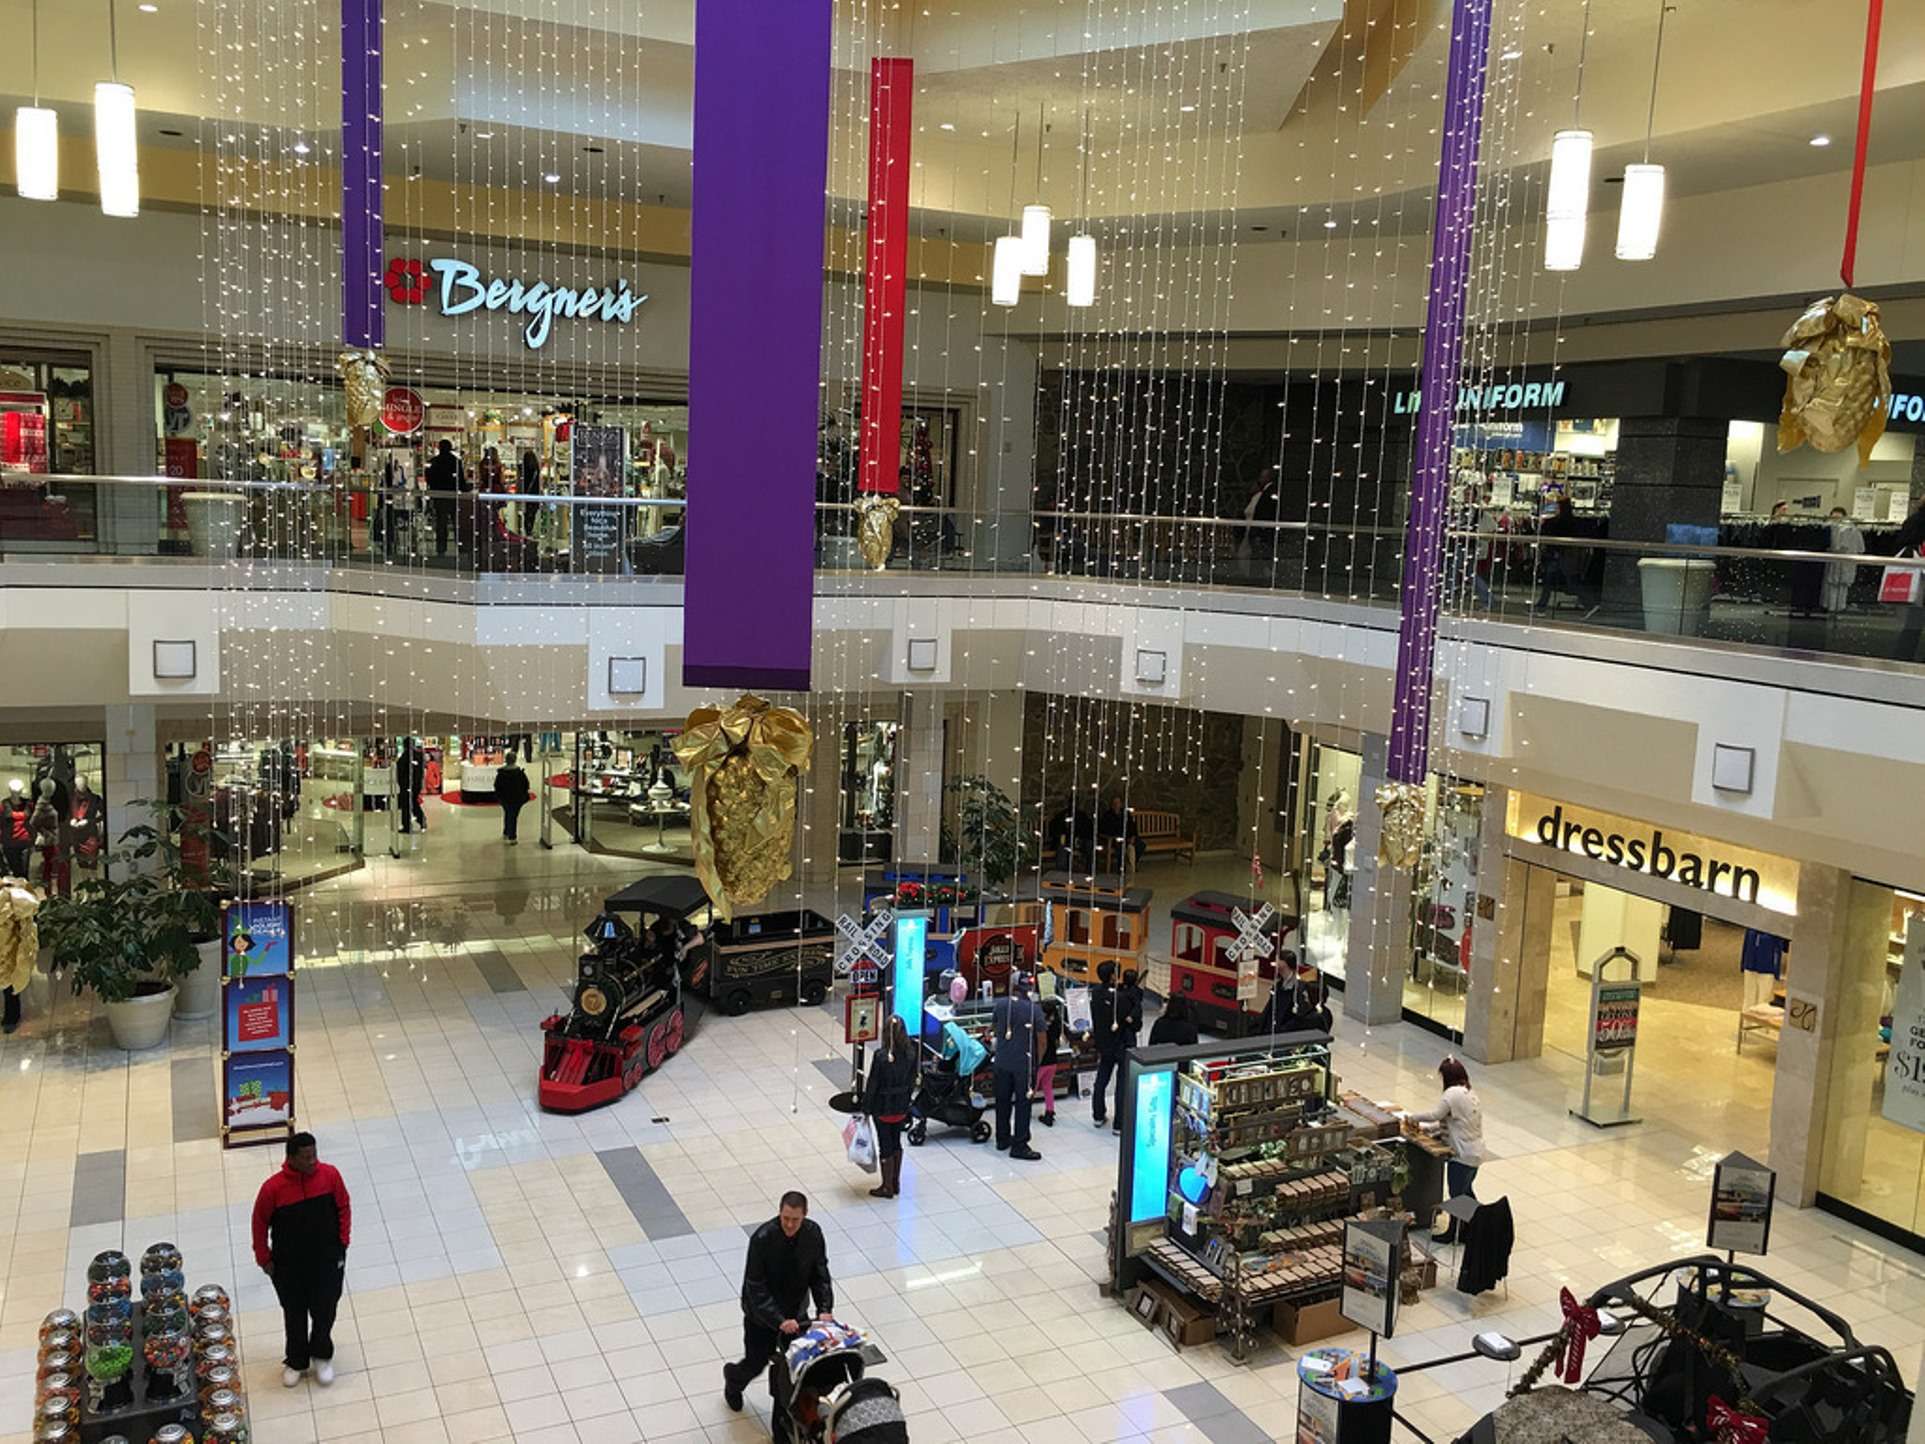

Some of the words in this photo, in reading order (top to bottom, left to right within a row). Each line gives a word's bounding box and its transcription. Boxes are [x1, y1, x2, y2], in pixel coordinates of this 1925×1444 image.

[430, 258, 649, 349] Bergner's
[1537, 805, 1760, 904] dressbarn
[837, 916, 858, 938] RAIL
[852, 971, 877, 983] OPEN
[1909, 1025, 1925, 1038] GE
[1909, 1037, 1925, 1050] FO
